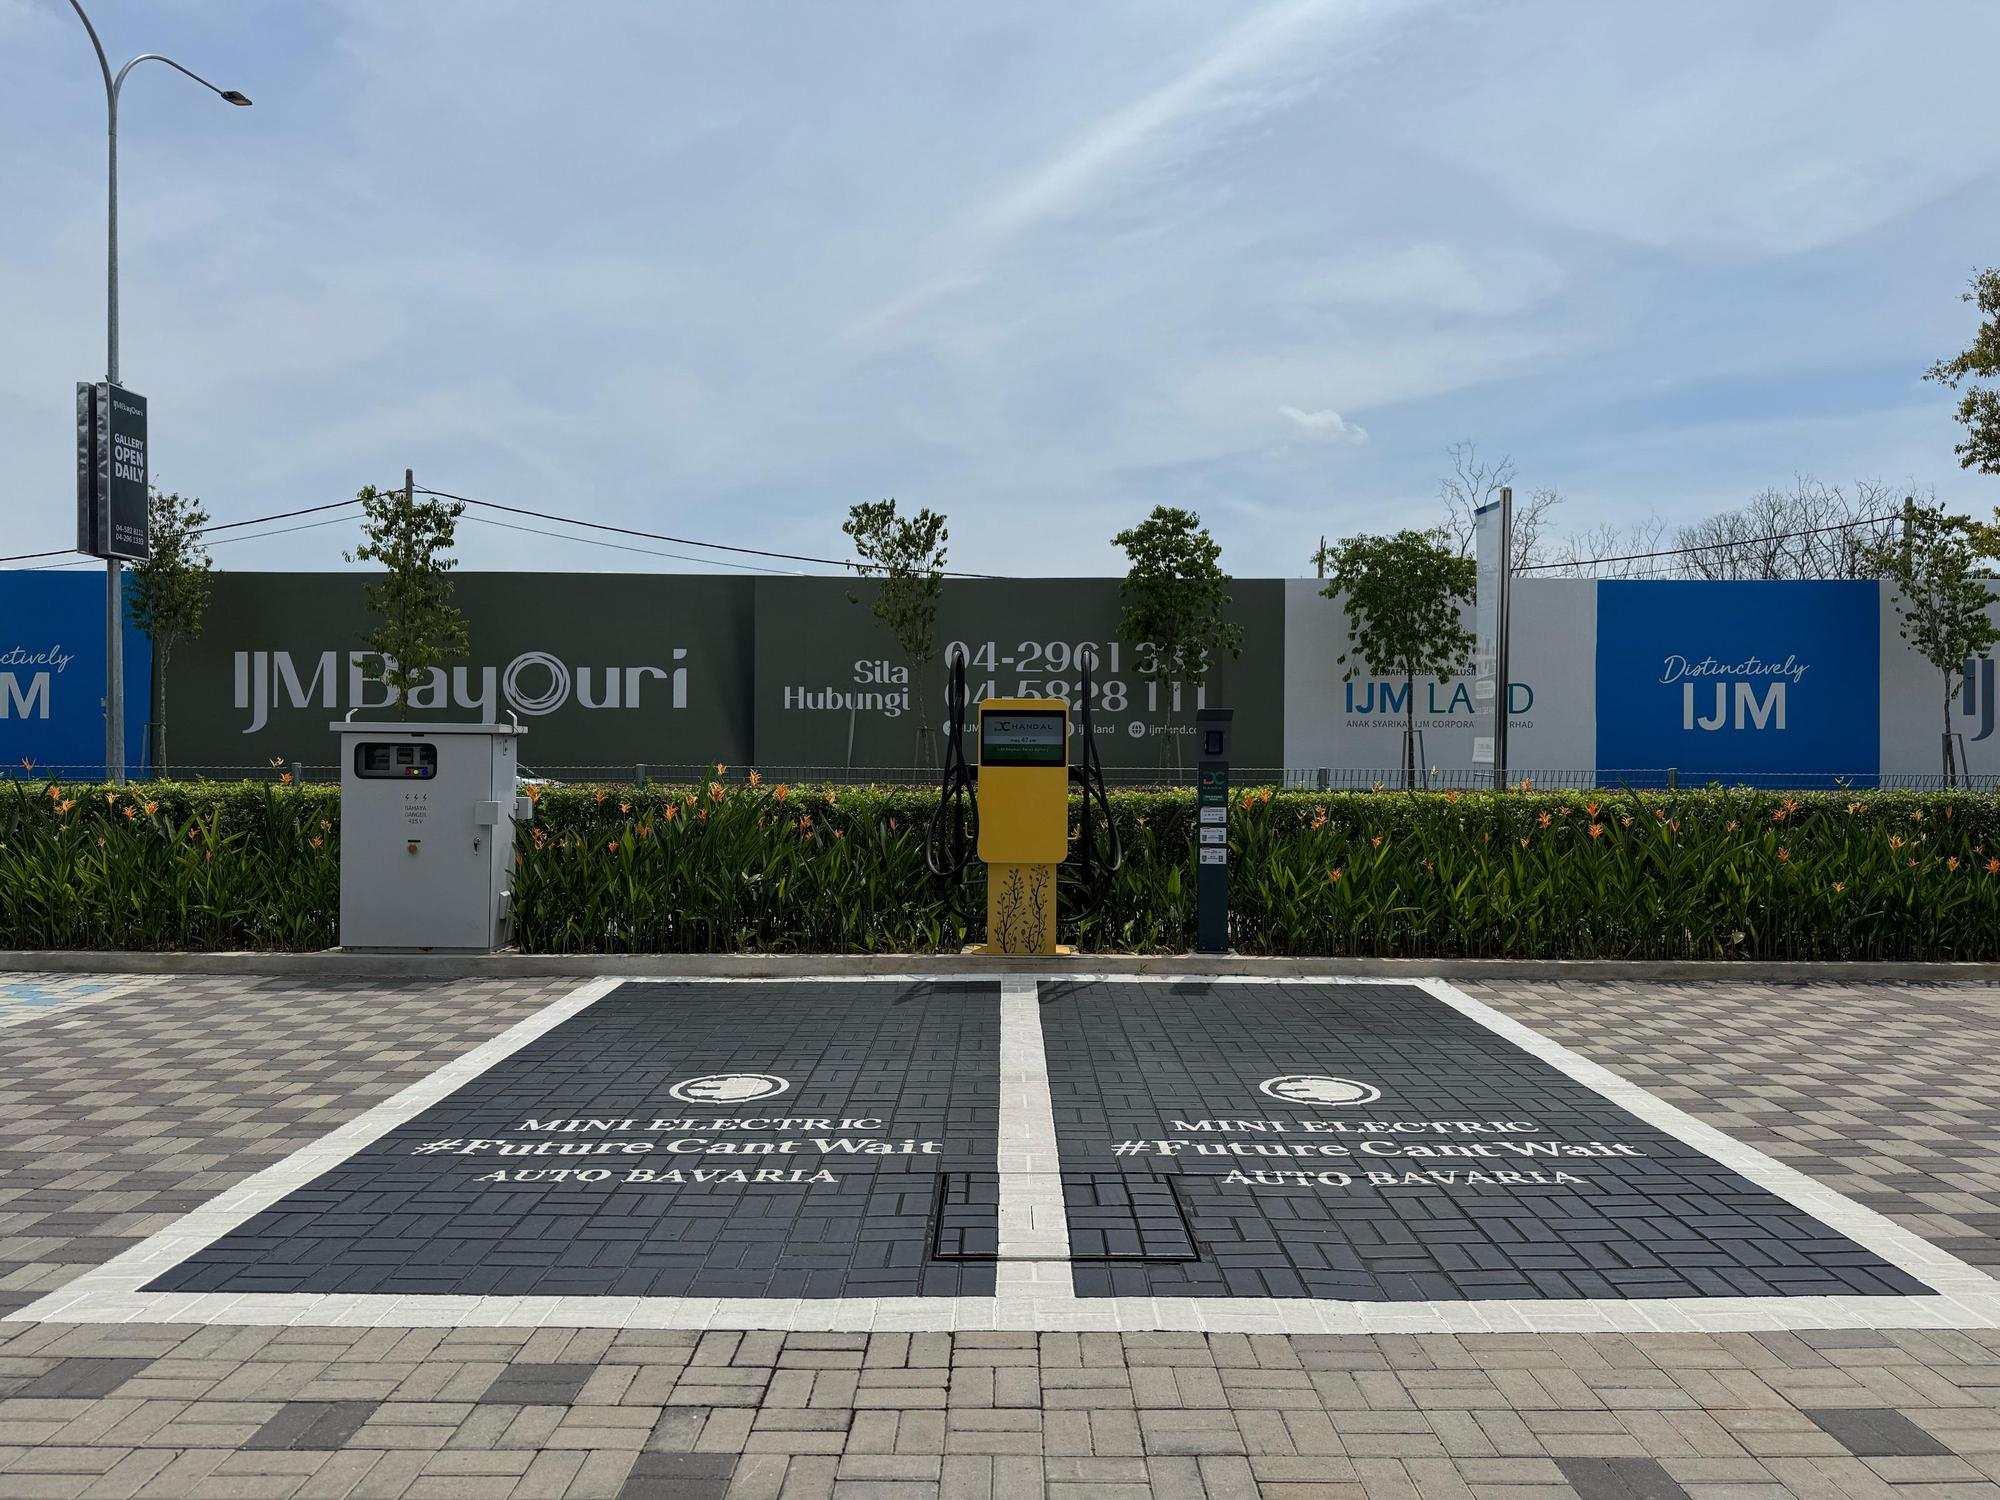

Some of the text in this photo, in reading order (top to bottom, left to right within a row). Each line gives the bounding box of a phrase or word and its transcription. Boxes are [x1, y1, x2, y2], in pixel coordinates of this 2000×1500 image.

[114, 433, 144, 451] GALLERY
[114, 445, 144, 467] OPEN
[115, 461, 144, 484] DAILY
[853, 660, 909, 684] Sila
[1404, 668, 1434, 676] POJEK
[1658, 654, 1810, 684] Distinctively
[784, 686, 911, 718] Hubungi
[1346, 682, 1409, 714] IJM
[1428, 682, 1534, 714] LAD
[1683, 682, 1786, 731] IJM
[1078, 724, 1115, 735] ijland
[1346, 720, 1370, 728] ANAK
[1372, 720, 1408, 728] SYARIKA
[1415, 720, 1430, 728] IJM
[1509, 720, 1534, 728] RHAD
[514, 1117, 882, 1132] MINI ELECTRIC
[1170, 1120, 1540, 1134] MINI ELECTRIC
[410, 1138, 943, 1156] #Future Cant Wait
[1110, 1140, 1353, 1157] #Future
[1500, 1141, 1649, 1158] Wait
[473, 1169, 839, 1183] AUTO BAVARIA
[1222, 1169, 1587, 1186] AUTO BAVARIA
